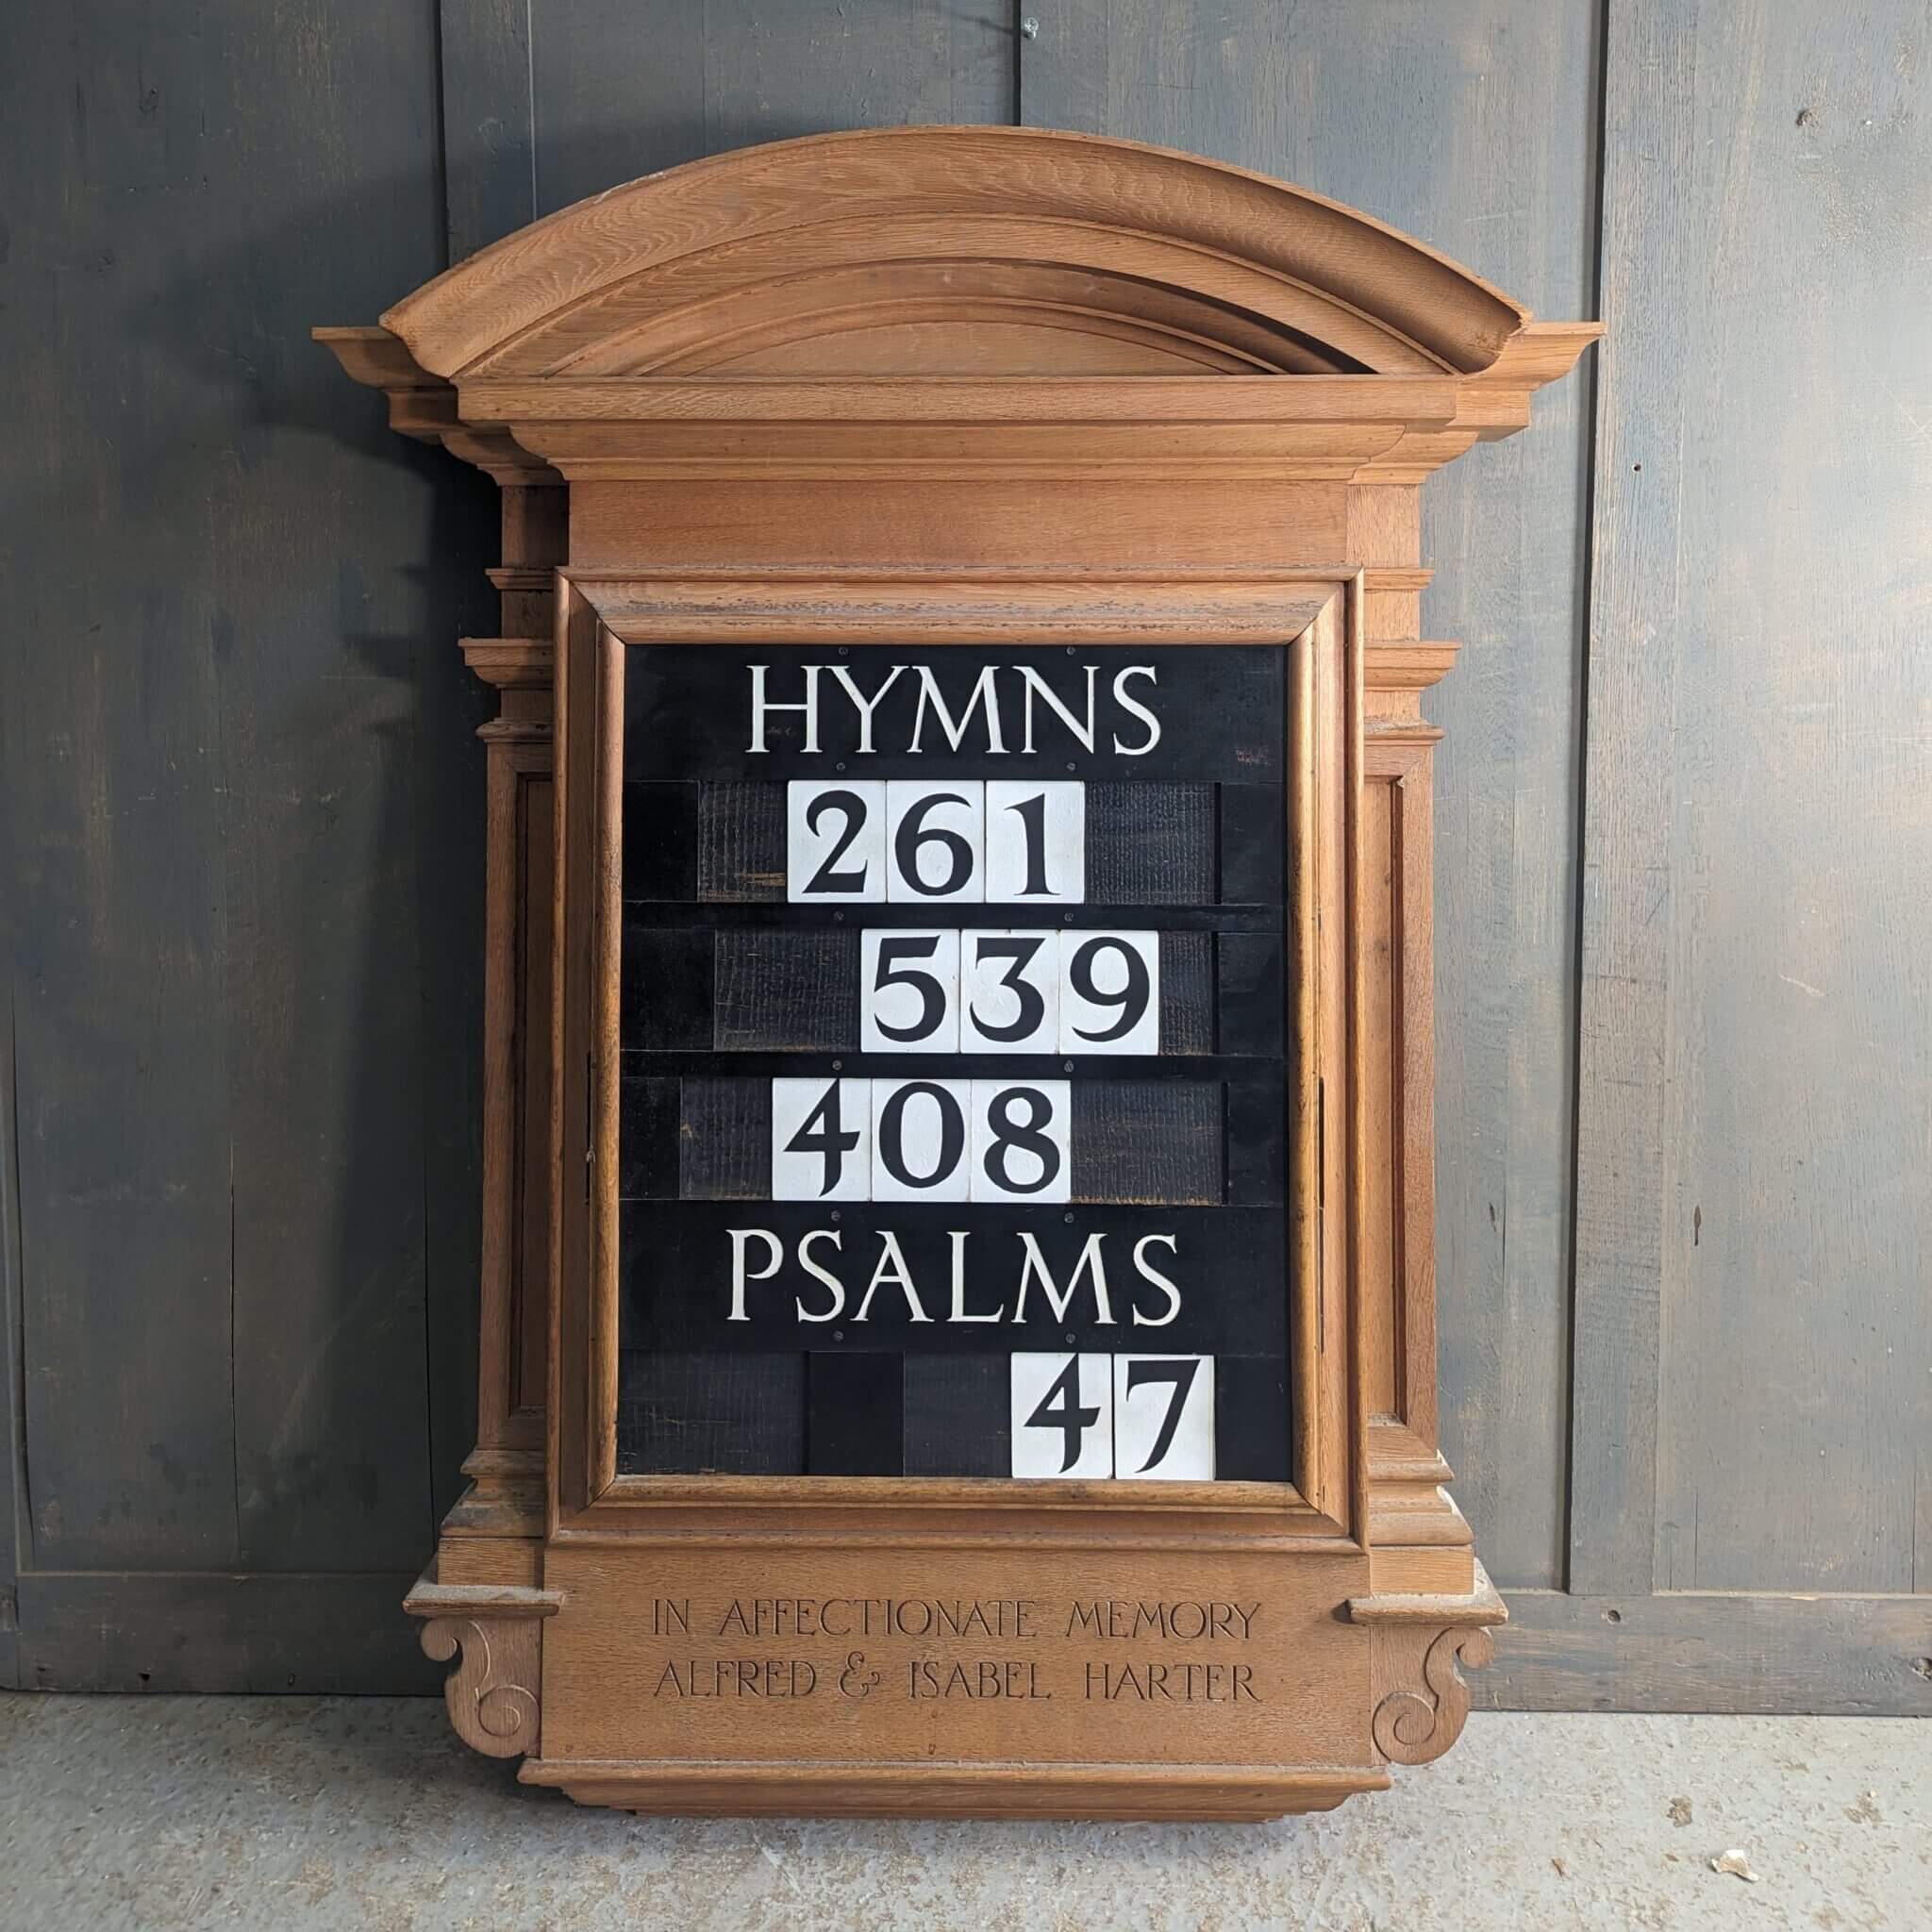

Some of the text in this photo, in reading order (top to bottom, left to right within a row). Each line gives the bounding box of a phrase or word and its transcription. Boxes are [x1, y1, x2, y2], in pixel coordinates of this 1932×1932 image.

[745, 665, 1162, 756] HYMNS
[802, 790, 1060, 896] 261
[874, 935, 1150, 1042] 539
[783, 1078, 1061, 1197] 408
[725, 1229, 1182, 1327] PSALMS
[1024, 1354, 1202, 1474] 47
[653, 1598, 1262, 1640] IN AFFECTIONATE MEMORY
[654, 1651, 1264, 1703] ALFRED & ISABEL HARTER
